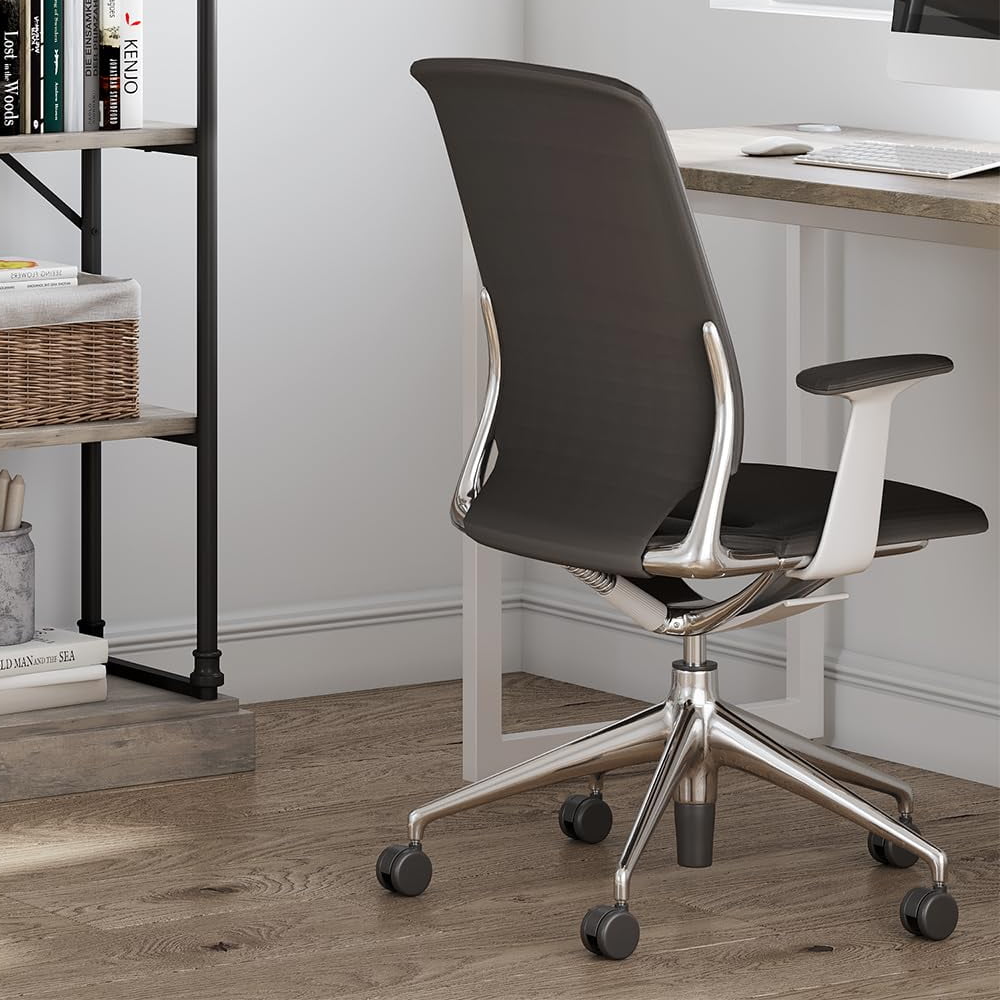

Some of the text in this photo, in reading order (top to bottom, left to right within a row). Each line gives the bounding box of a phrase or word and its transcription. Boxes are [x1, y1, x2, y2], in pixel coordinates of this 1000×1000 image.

[3, 30, 19, 60] Lost
[123, 39, 139, 95] KENJO
[3, 80, 19, 127] Woods
[14, 656, 34, 668] MAN
[47, 656, 57, 664] THE
[59, 650, 75, 662] SEA
